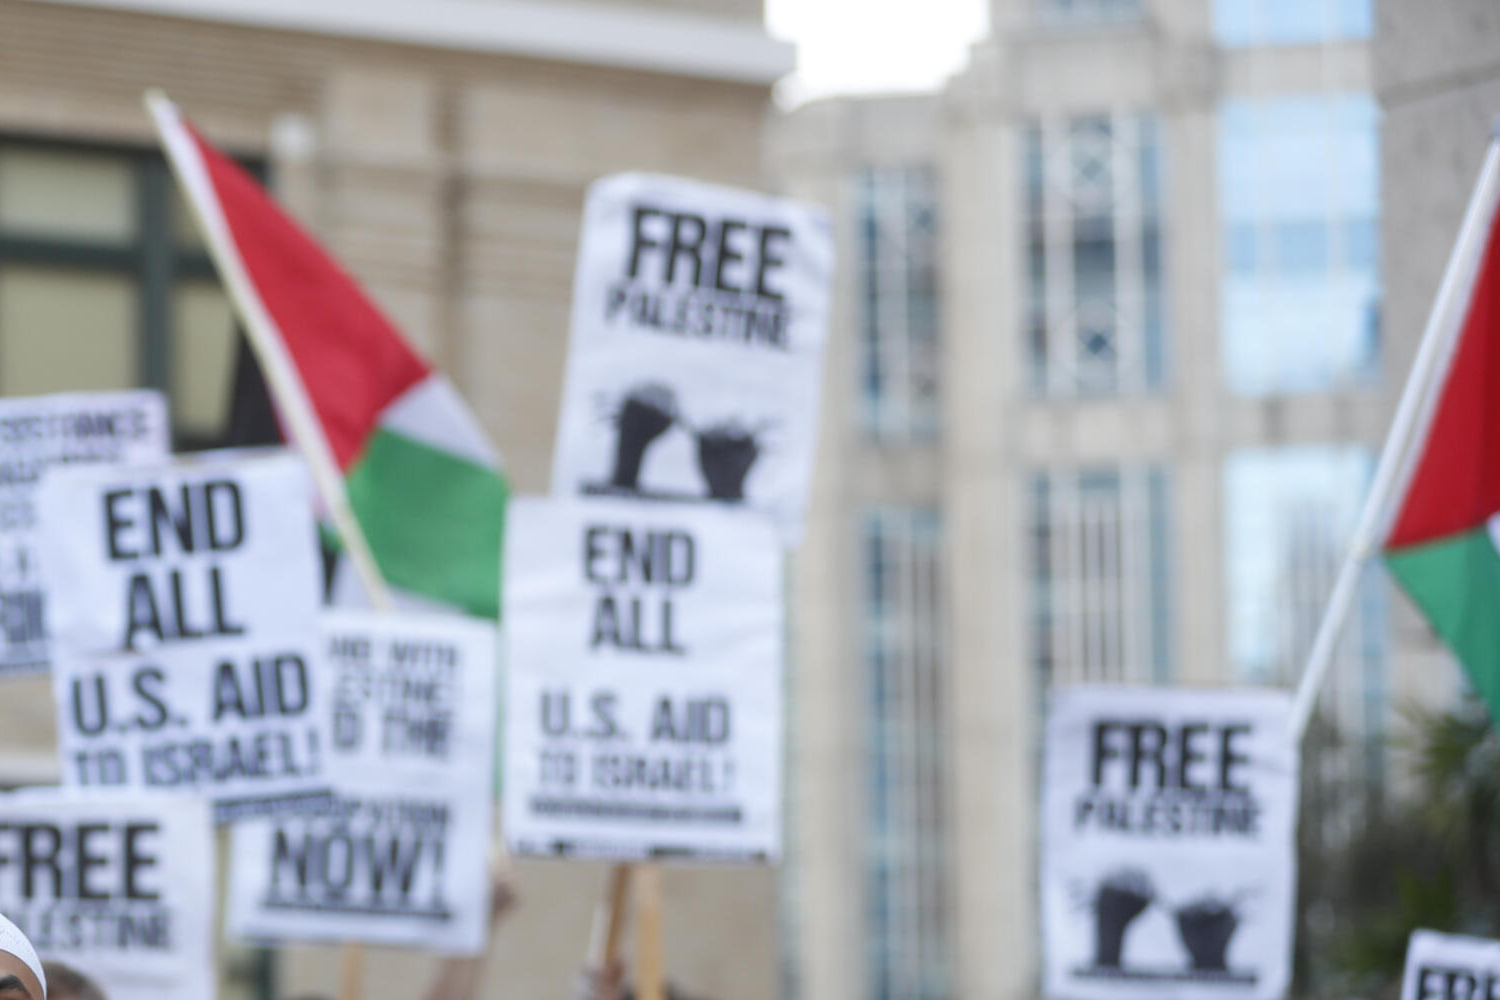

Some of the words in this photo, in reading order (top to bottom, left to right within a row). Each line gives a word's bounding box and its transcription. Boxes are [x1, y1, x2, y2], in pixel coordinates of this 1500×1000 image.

[628, 206, 792, 300] FREE
[604, 286, 791, 352] PALESTINE
[104, 478, 245, 559] END
[583, 525, 695, 587] END
[124, 564, 246, 652] ALL
[591, 594, 687, 654] ALL
[72, 664, 188, 738] U.S.
[212, 653, 311, 724] AID
[540, 690, 633, 742] U.S.
[651, 694, 731, 745] AID
[75, 745, 127, 786] TO
[140, 726, 320, 788] ISRAEL!
[538, 750, 576, 785] TO
[592, 752, 736, 793] ISRAEL!
[1091, 717, 1255, 793] FREE
[1072, 800, 1262, 840] PALESTINE
[268, 826, 446, 904] NOW!
